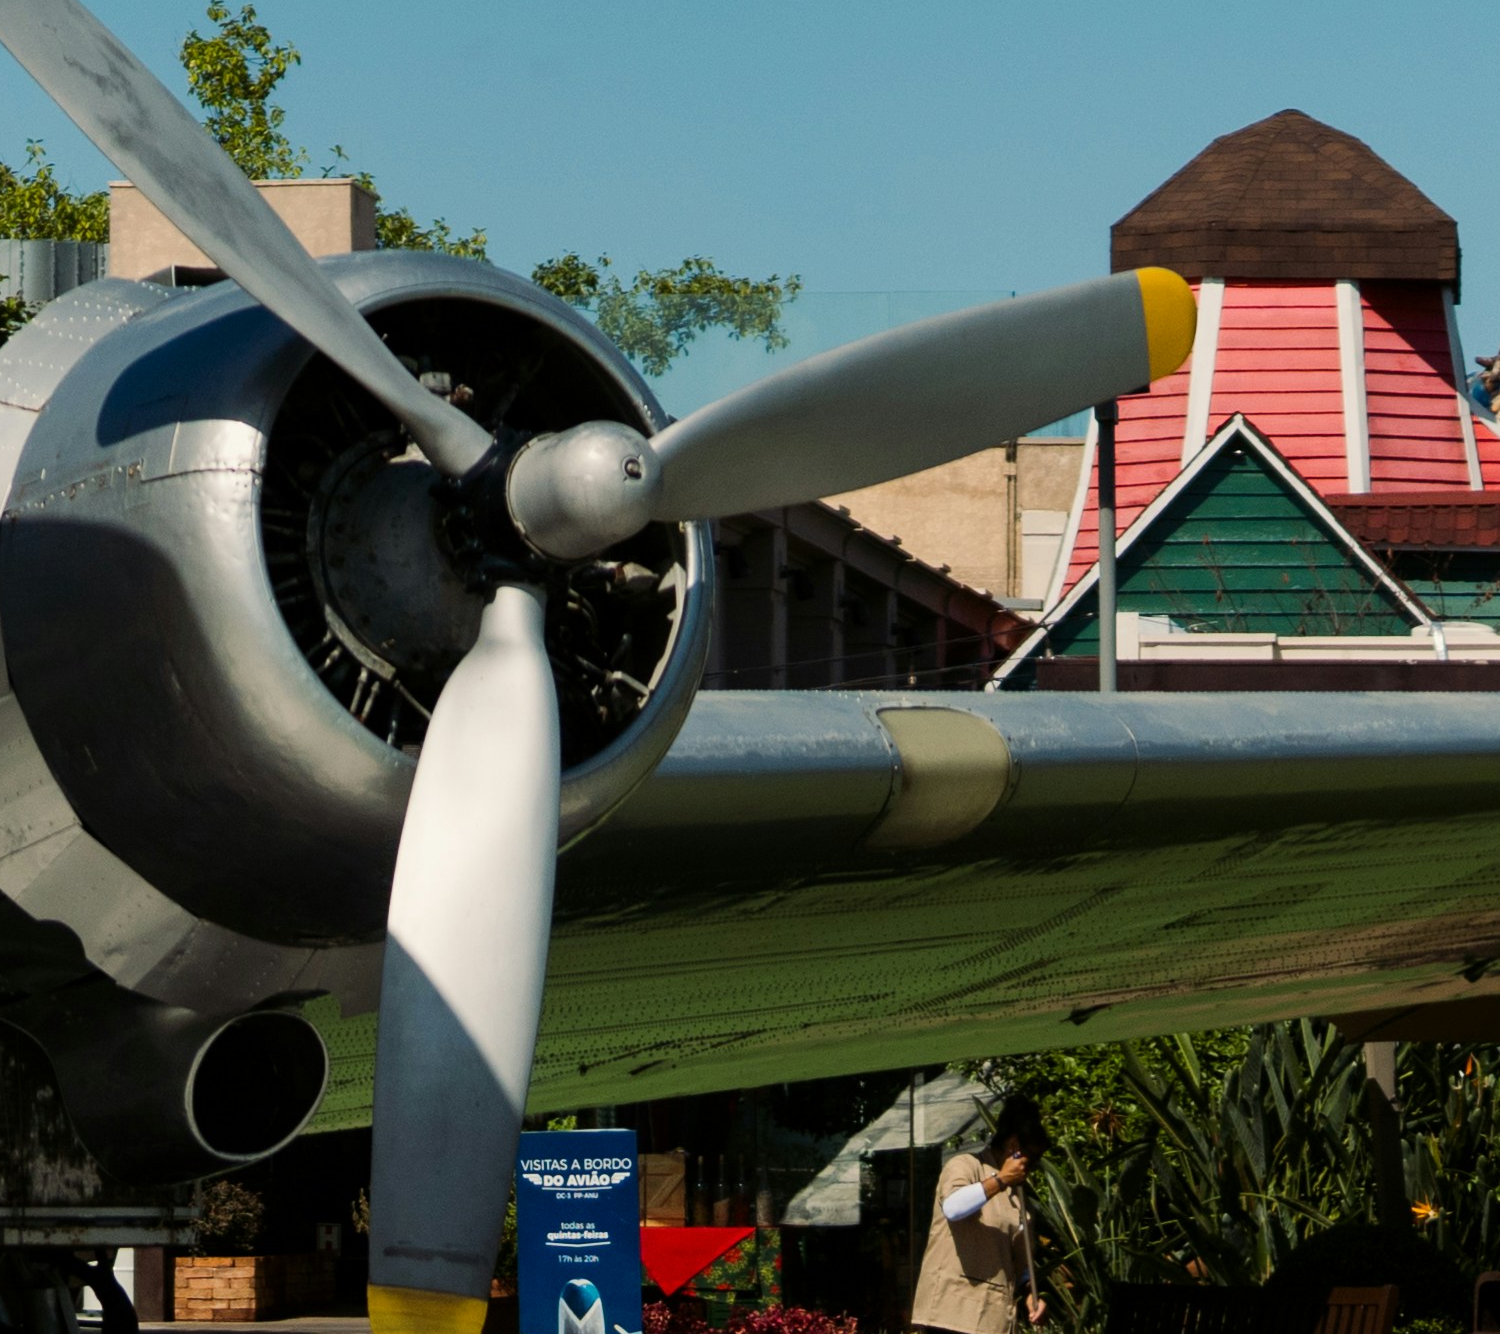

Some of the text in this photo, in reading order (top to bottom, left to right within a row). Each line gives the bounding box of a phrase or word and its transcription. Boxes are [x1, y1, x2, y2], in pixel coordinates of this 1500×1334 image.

[520, 1158, 632, 1171] VISITAS A BORDO
[543, 1171, 611, 1187] DO AVIÃO
[561, 1221, 585, 1230] todas
